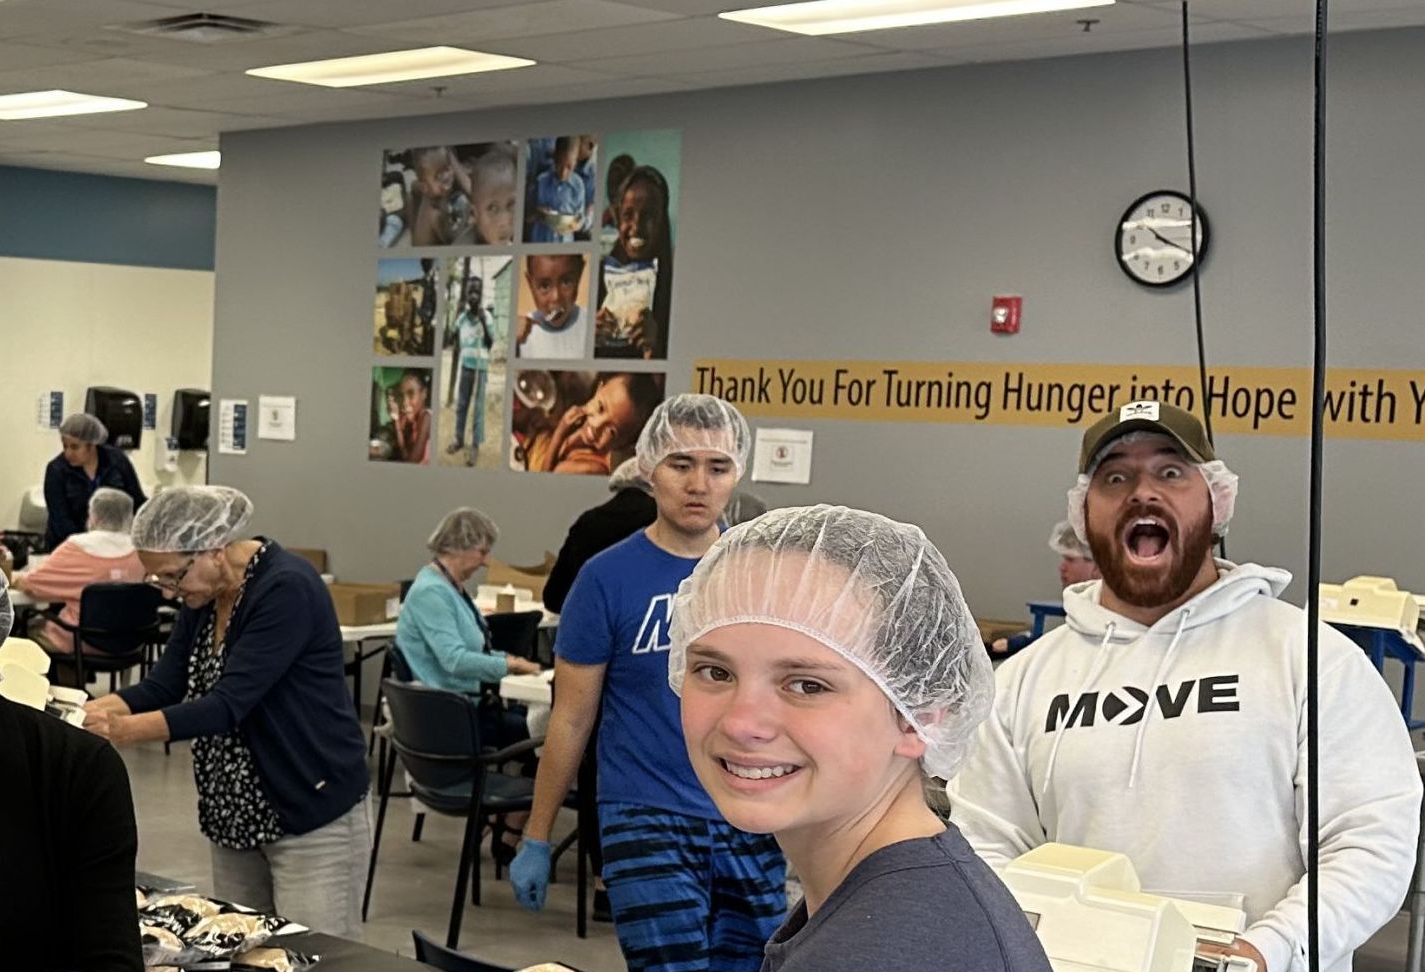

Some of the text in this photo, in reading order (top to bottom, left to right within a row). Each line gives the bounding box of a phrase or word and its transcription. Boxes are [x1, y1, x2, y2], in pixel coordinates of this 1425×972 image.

[696, 366, 772, 404] Thank
[778, 367, 824, 405] You
[832, 368, 877, 407] For
[882, 369, 992, 421] Turning
[1002, 372, 1121, 424] Hunger
[1130, 374, 1195, 411] into
[1207, 375, 1298, 430] Hope
[1322, 378, 1397, 424] with
[1044, 673, 1241, 734] MOVE
